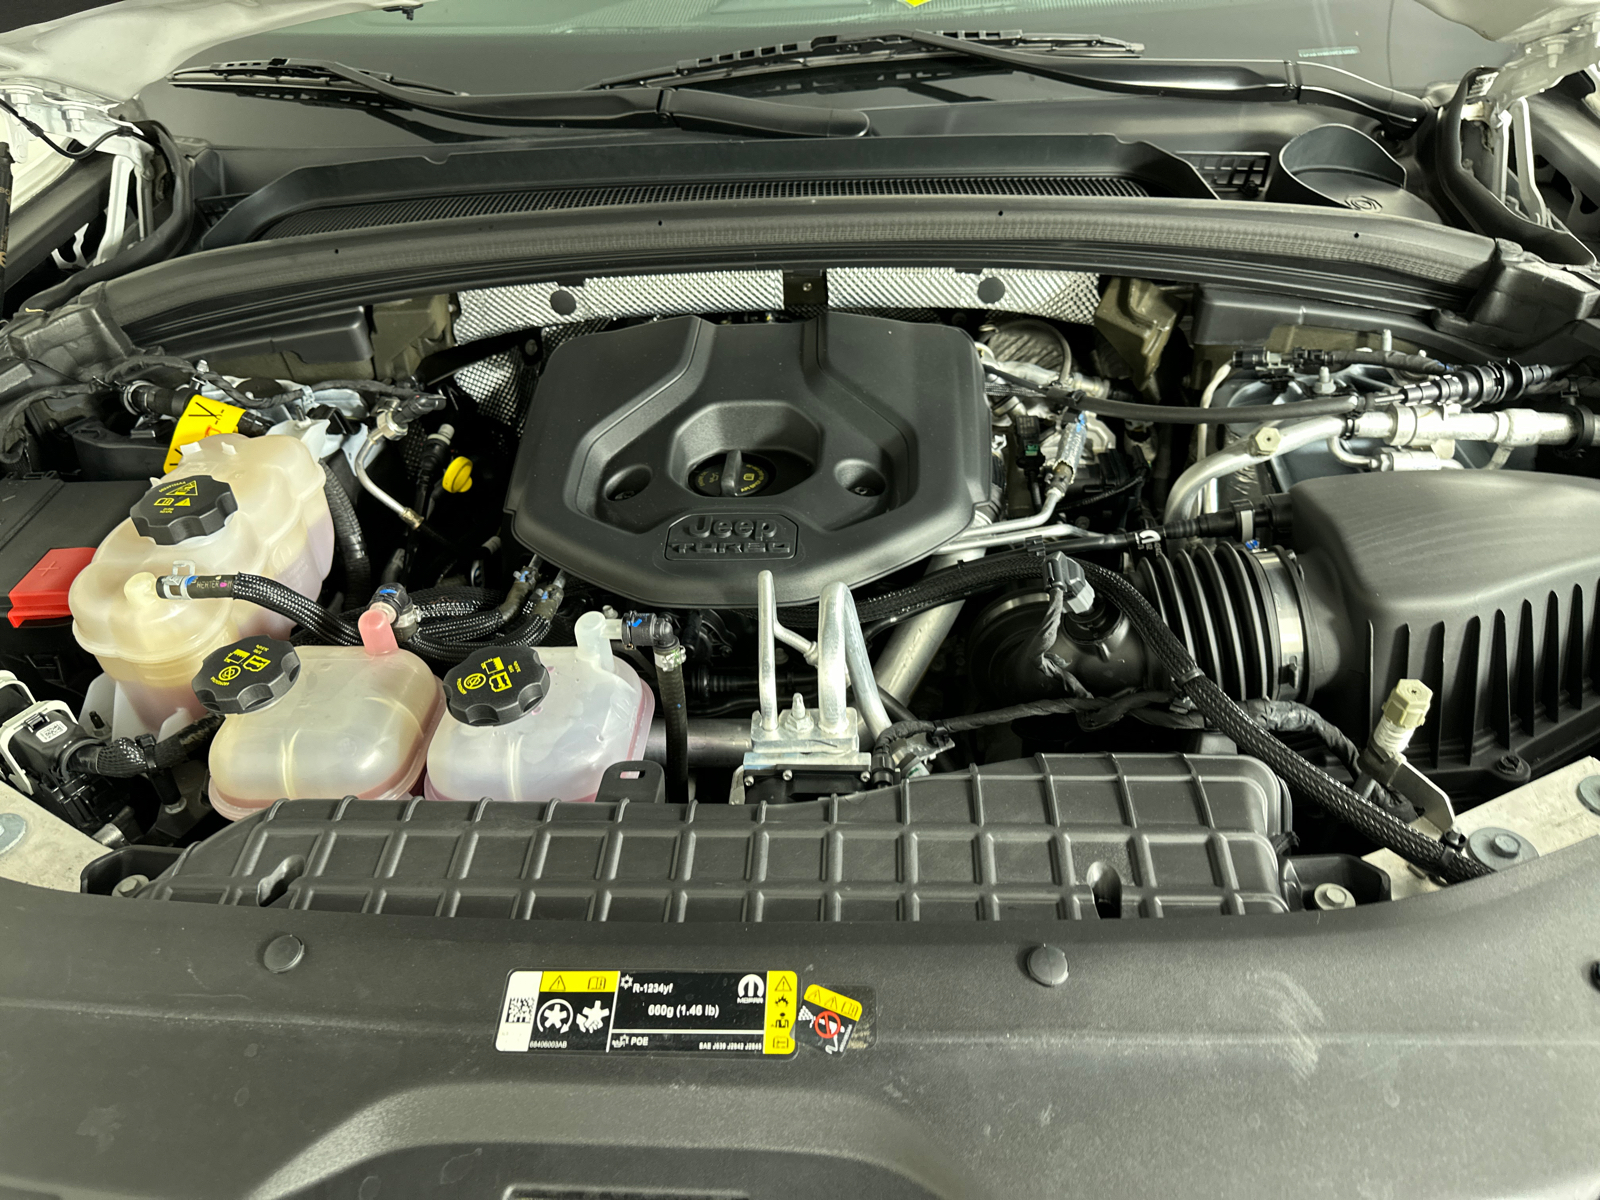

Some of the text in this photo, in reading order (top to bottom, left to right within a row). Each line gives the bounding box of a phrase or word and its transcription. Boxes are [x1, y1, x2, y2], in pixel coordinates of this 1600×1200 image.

[687, 515, 778, 541] Jeep
[670, 542, 791, 554] TURBO
[632, 982, 674, 994] R-1234yf
[676, 1003, 702, 1018] (1.46
[704, 1003, 720, 1018] lb)
[630, 1036, 649, 1046] POE
